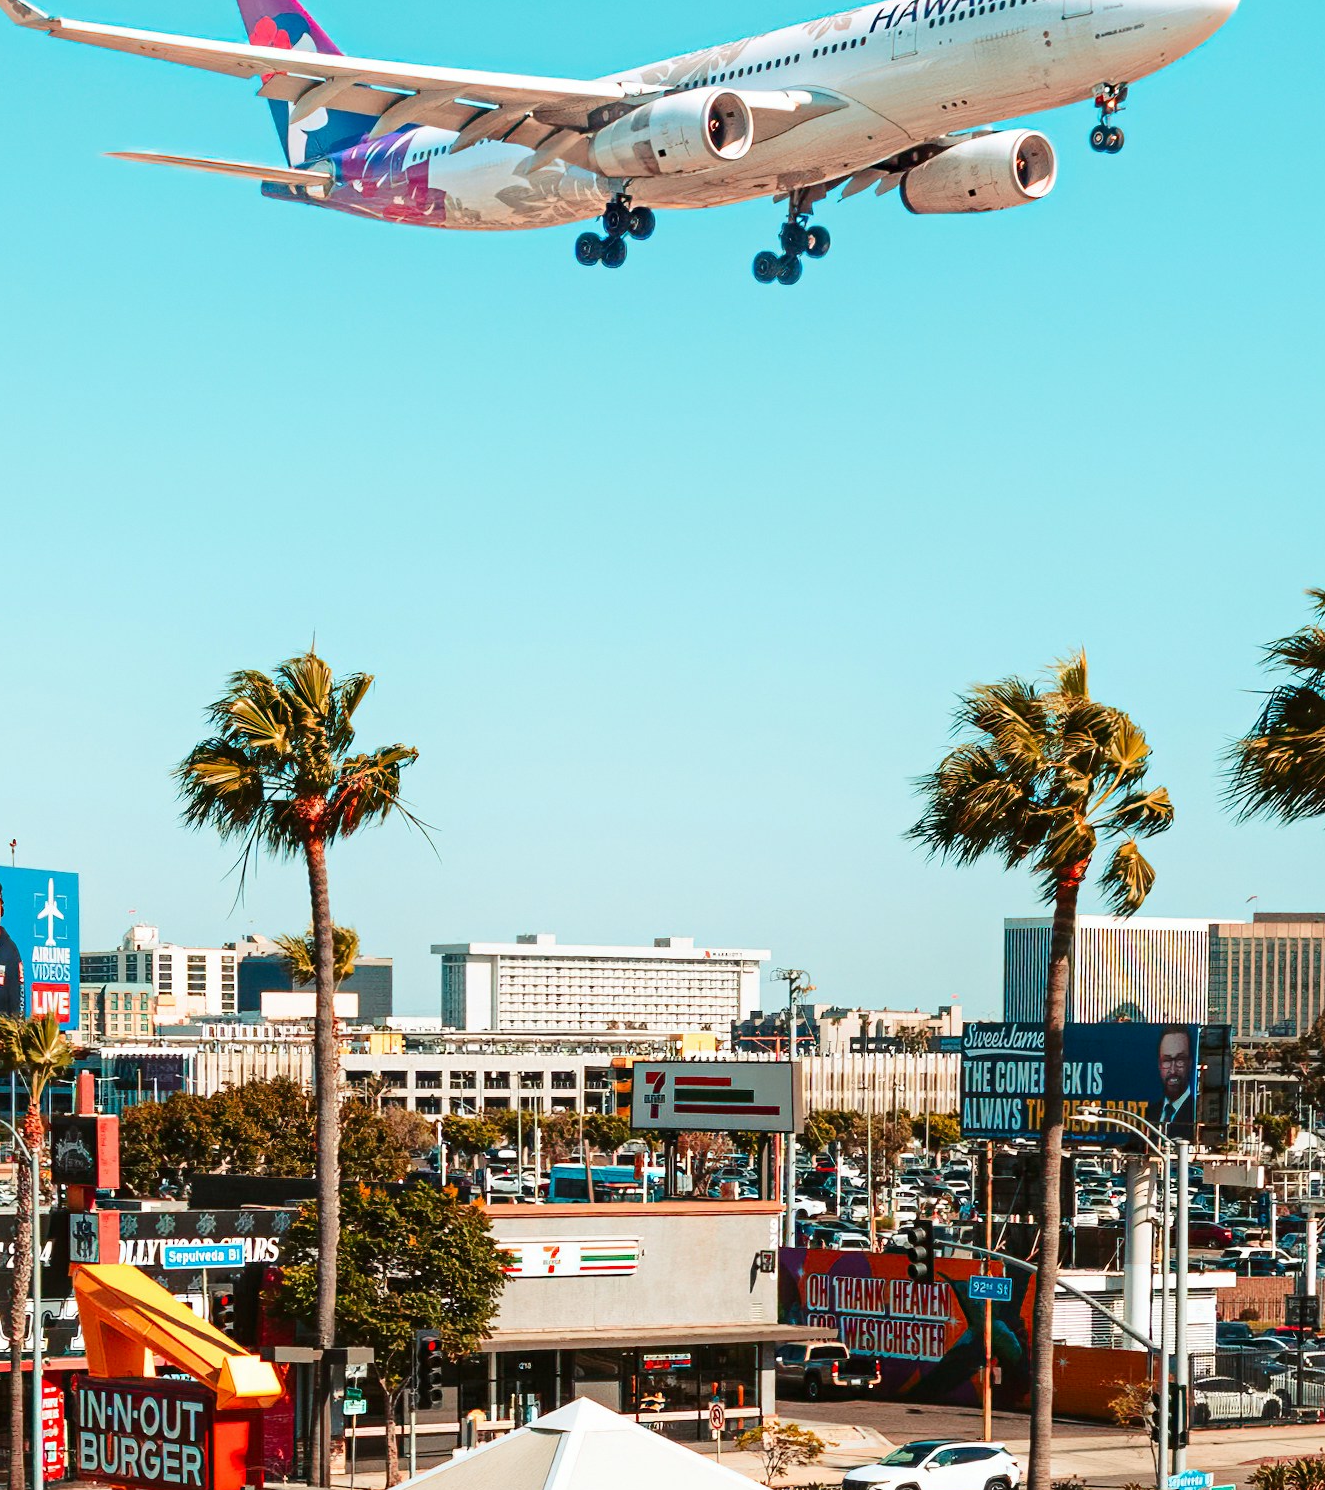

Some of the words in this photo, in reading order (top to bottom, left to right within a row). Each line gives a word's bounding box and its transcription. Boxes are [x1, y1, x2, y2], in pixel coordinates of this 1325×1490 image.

[32, 946, 71, 964] AIRLINE
[32, 964, 70, 982] VIDEOS
[32, 991, 70, 1015] LIVE
[1003, 1024, 1046, 1050] Jame
[964, 1061, 991, 1093] THE
[996, 1061, 1083, 1094] COMECK
[1087, 1062, 1103, 1094] IS
[963, 1098, 1022, 1130] ALWAYS
[1026, 1098, 1045, 1130] TH
[168, 1250, 225, 1266] Sepulveda
[807, 1274, 829, 1311] OH
[834, 1276, 886, 1315] THANK
[890, 1279, 953, 1321] HEAVEN
[996, 1284, 1009, 1296] St
[841, 1316, 946, 1362] WESTCHESTER
[79, 1431, 203, 1487] BURGER
